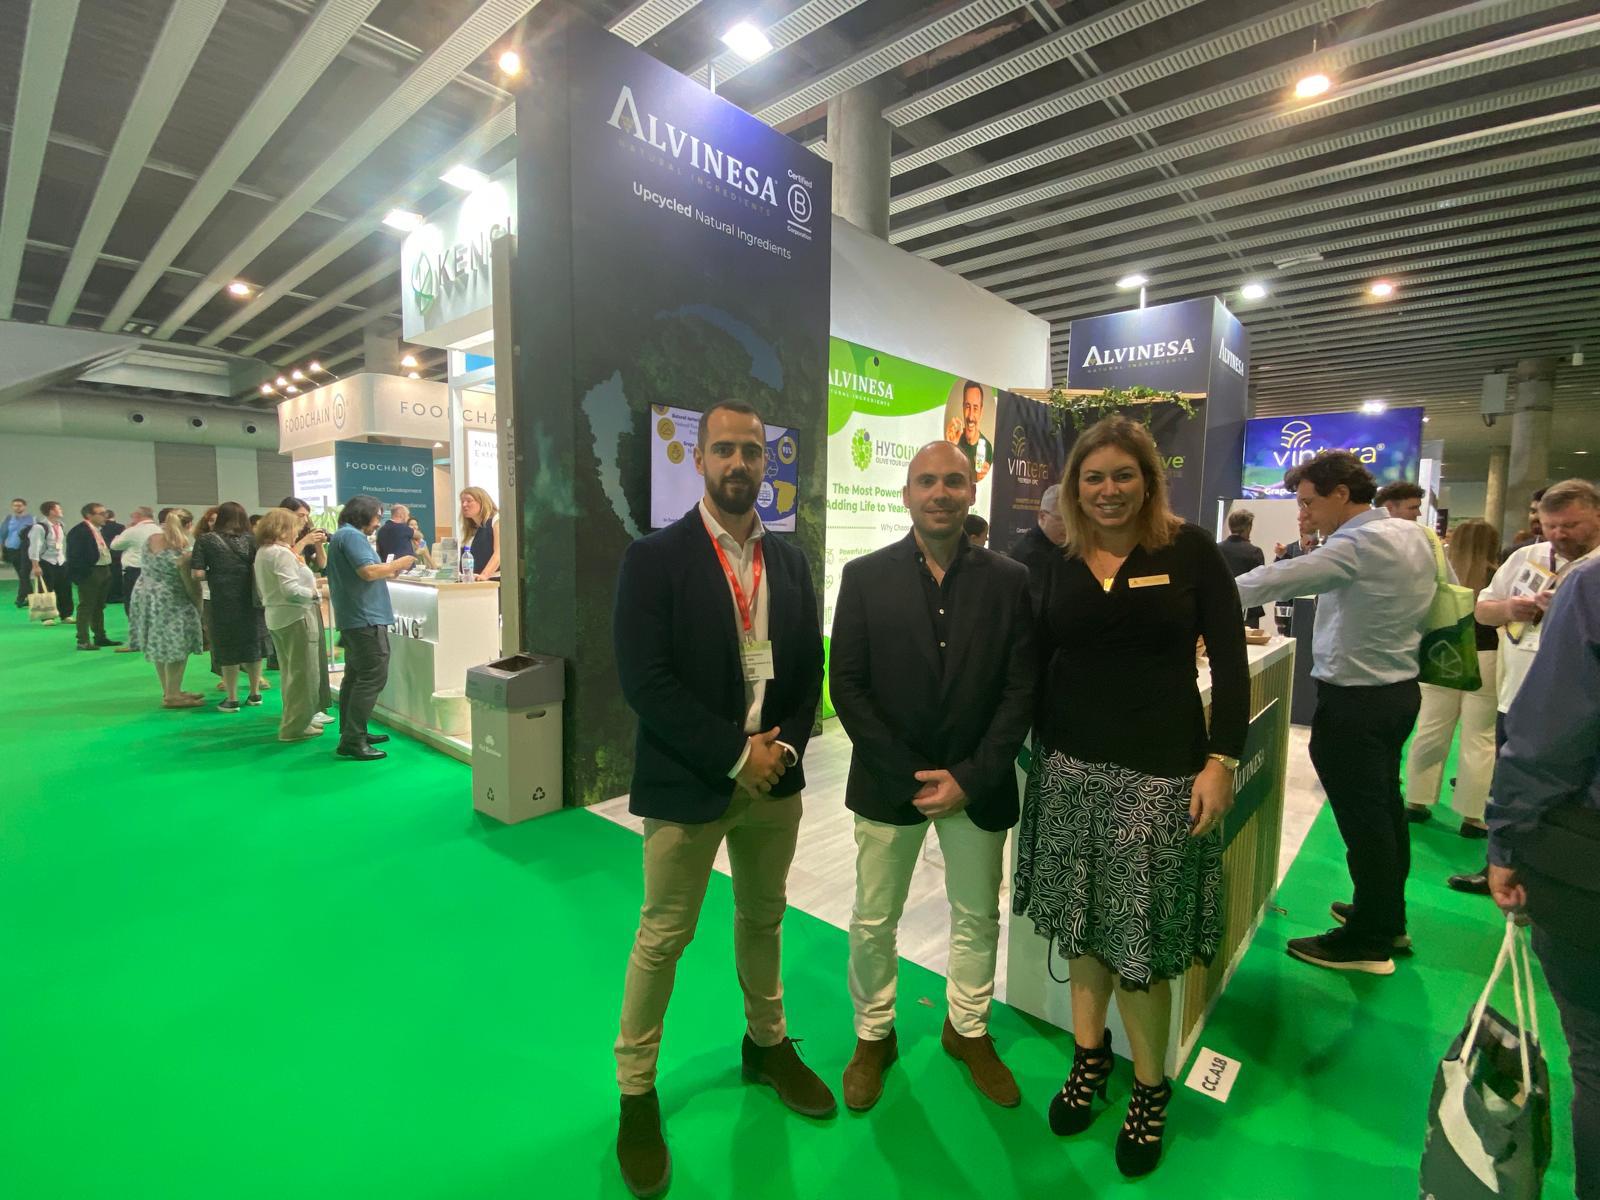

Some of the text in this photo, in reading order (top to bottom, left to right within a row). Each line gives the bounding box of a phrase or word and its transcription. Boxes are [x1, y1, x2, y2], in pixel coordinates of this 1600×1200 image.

[606, 85, 779, 207] ALVINESA
[787, 169, 813, 189] Certified
[632, 180, 792, 260] Upcycled Natural Ingredients
[1082, 338, 1195, 368] ALVINESA
[1218, 337, 1244, 377] ALVINESA
[284, 406, 330, 432] FOODCHAIN
[345, 461, 409, 472] FOODCHAIN
[1007, 457, 1049, 480] vintera
[832, 482, 850, 494] The
[852, 485, 873, 496] Most
[826, 499, 858, 513] Adding
[860, 500, 876, 512] Life
[877, 502, 886, 513] to
[1201, 1056, 1228, 1092] CC.A18
